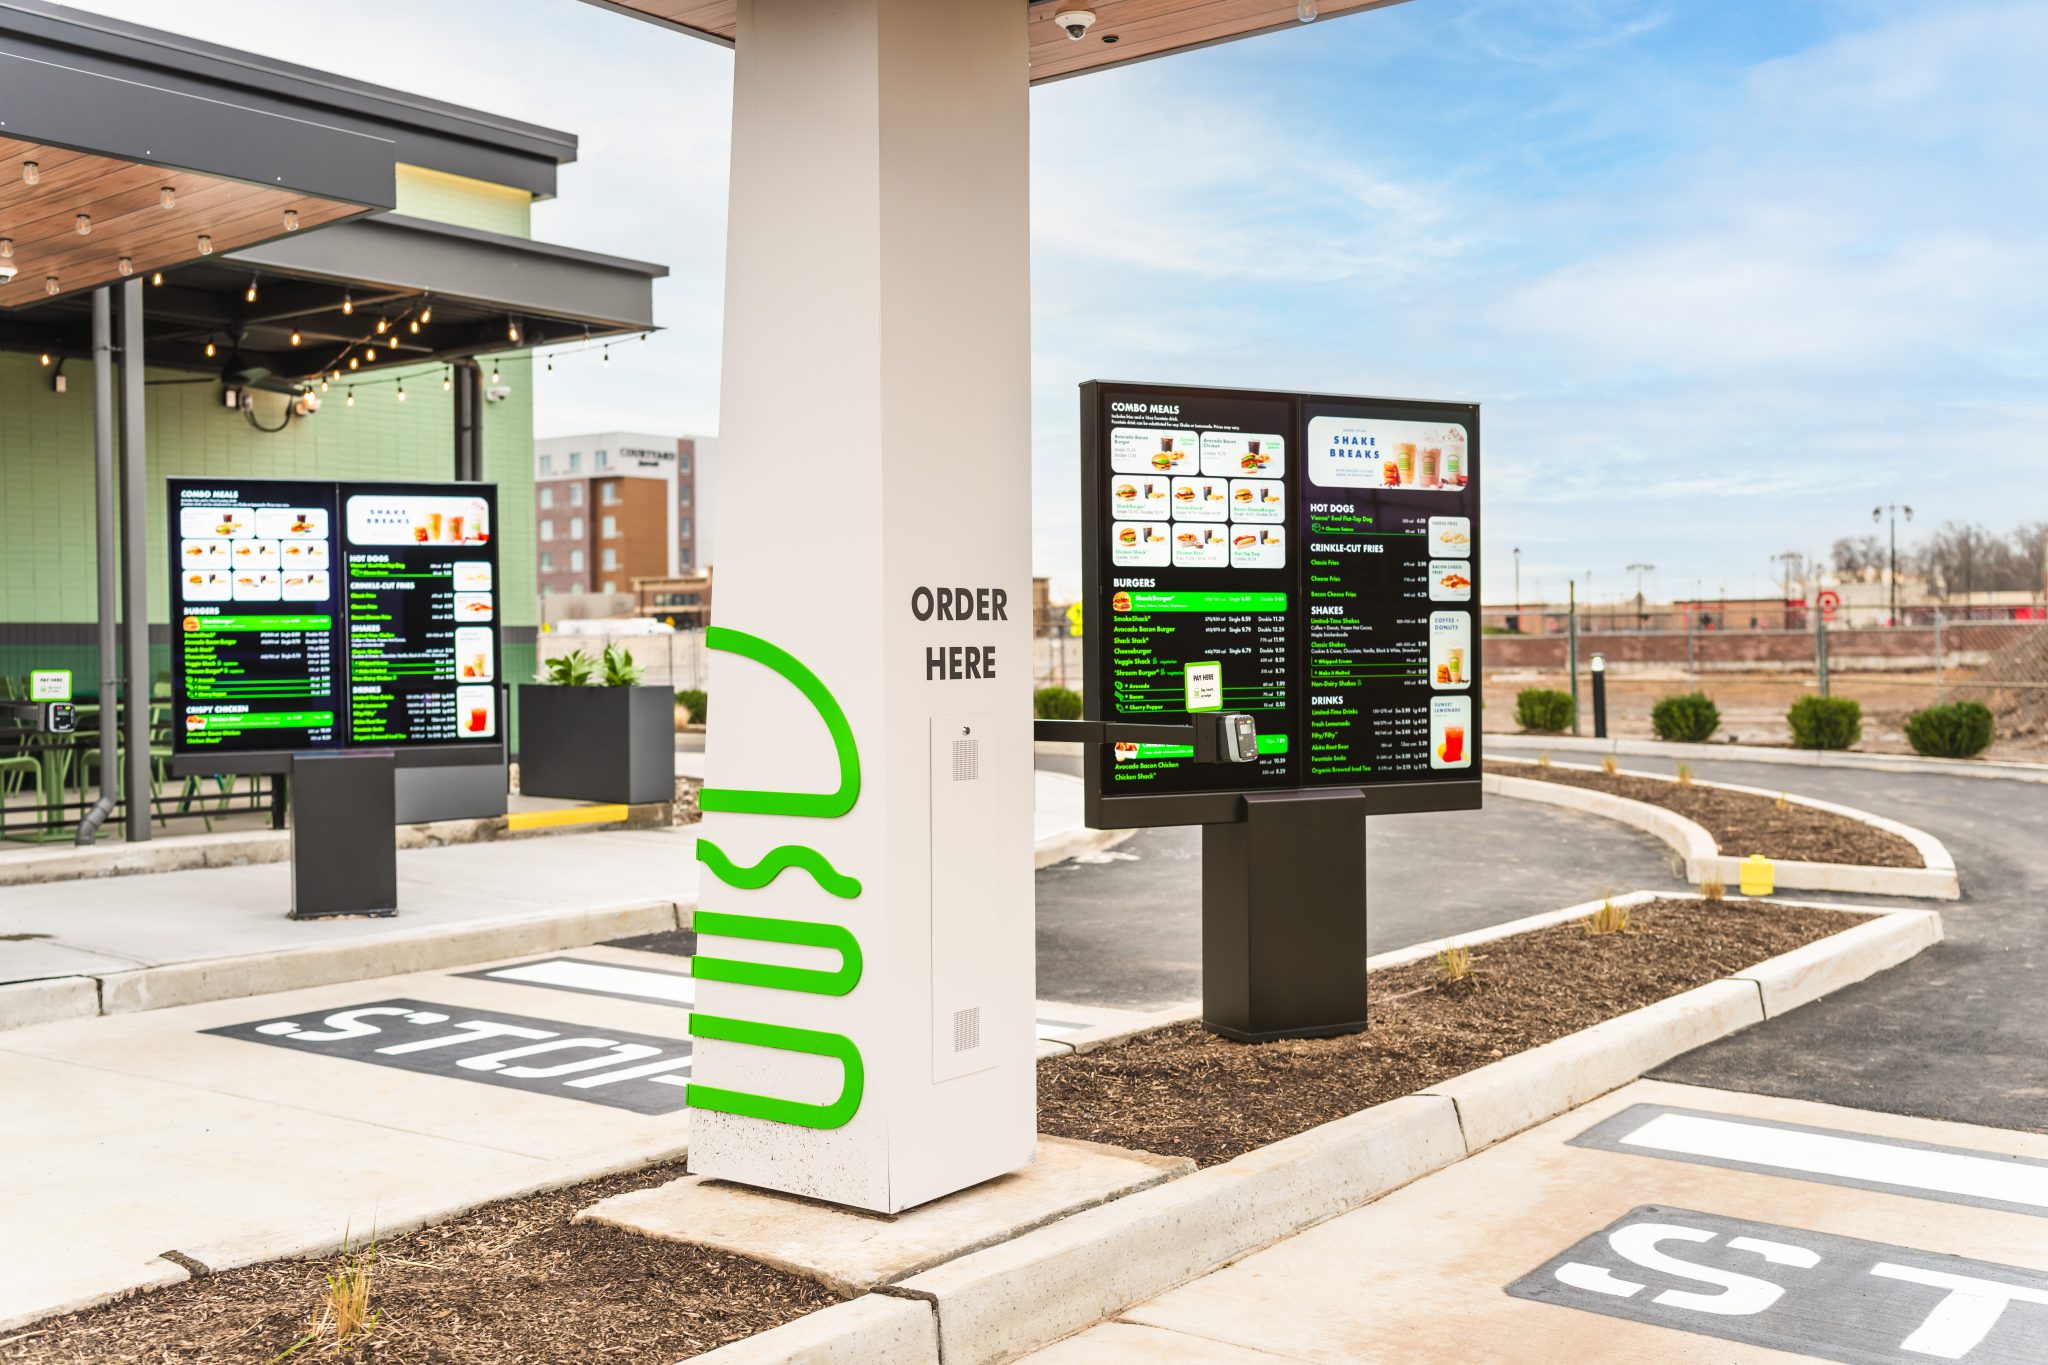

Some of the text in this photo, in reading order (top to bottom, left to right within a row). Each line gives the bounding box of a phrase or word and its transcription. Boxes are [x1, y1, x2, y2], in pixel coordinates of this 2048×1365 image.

[1112, 402, 1179, 414] COMBO MEALS
[1334, 436, 1375, 446] SHAKE
[1330, 449, 1379, 459] BREAKS
[1310, 504, 1354, 513] HOT DOGS
[1311, 544, 1383, 553] CRINKLE-CUT FRIES
[1114, 578, 1155, 587] BURGERS
[912, 586, 1008, 621] ORDER
[1311, 606, 1343, 615] SHAKES
[927, 646, 995, 680] HERE
[1312, 696, 1343, 705] DRINKS
[1554, 1222, 2048, 1359] ST
